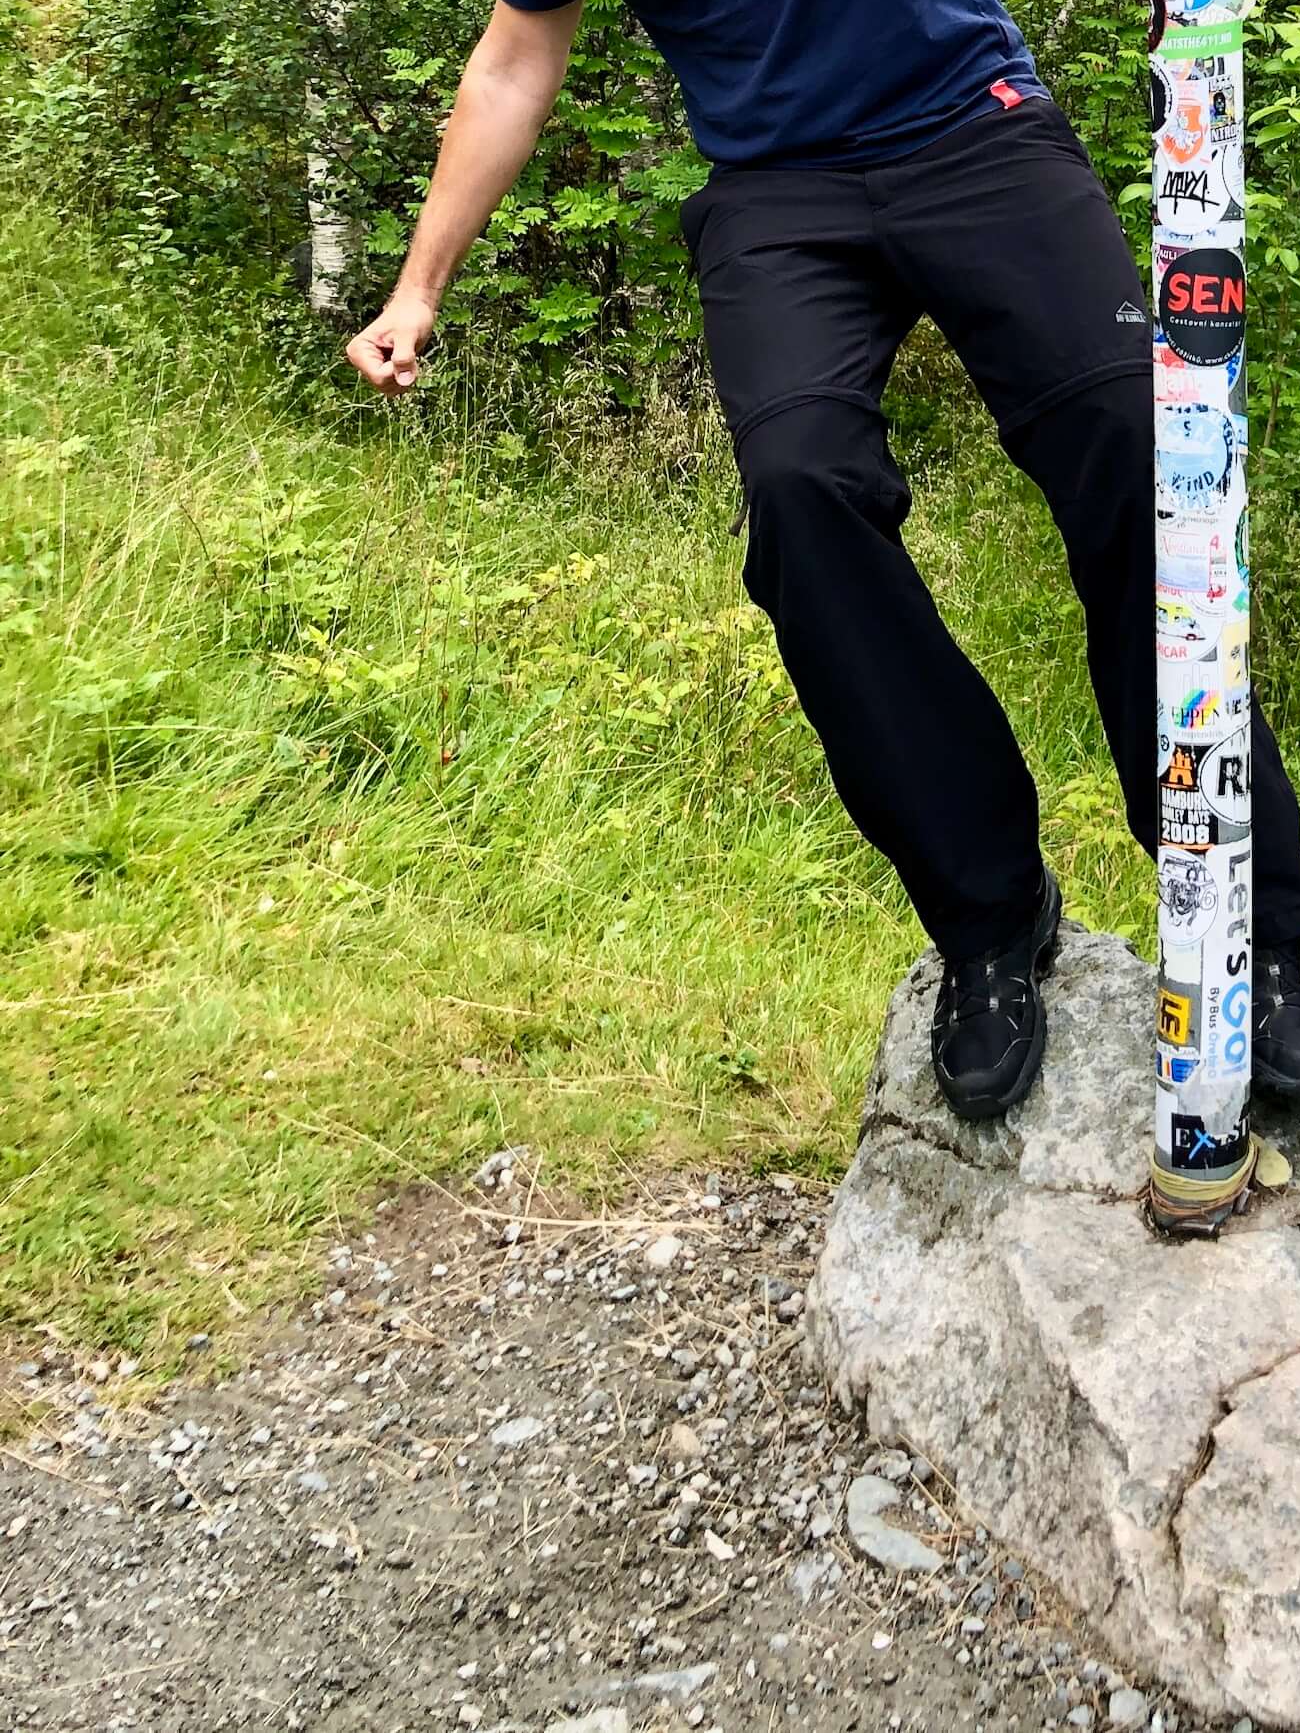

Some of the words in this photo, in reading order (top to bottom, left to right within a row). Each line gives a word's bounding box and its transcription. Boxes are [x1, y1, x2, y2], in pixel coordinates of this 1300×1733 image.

[1167, 272, 1244, 315] SEN
[1161, 819, 1210, 845] 2008
[1226, 849, 1251, 977] Let's
[1207, 987, 1220, 1004] By
[1208, 1005, 1220, 1029] Bus
